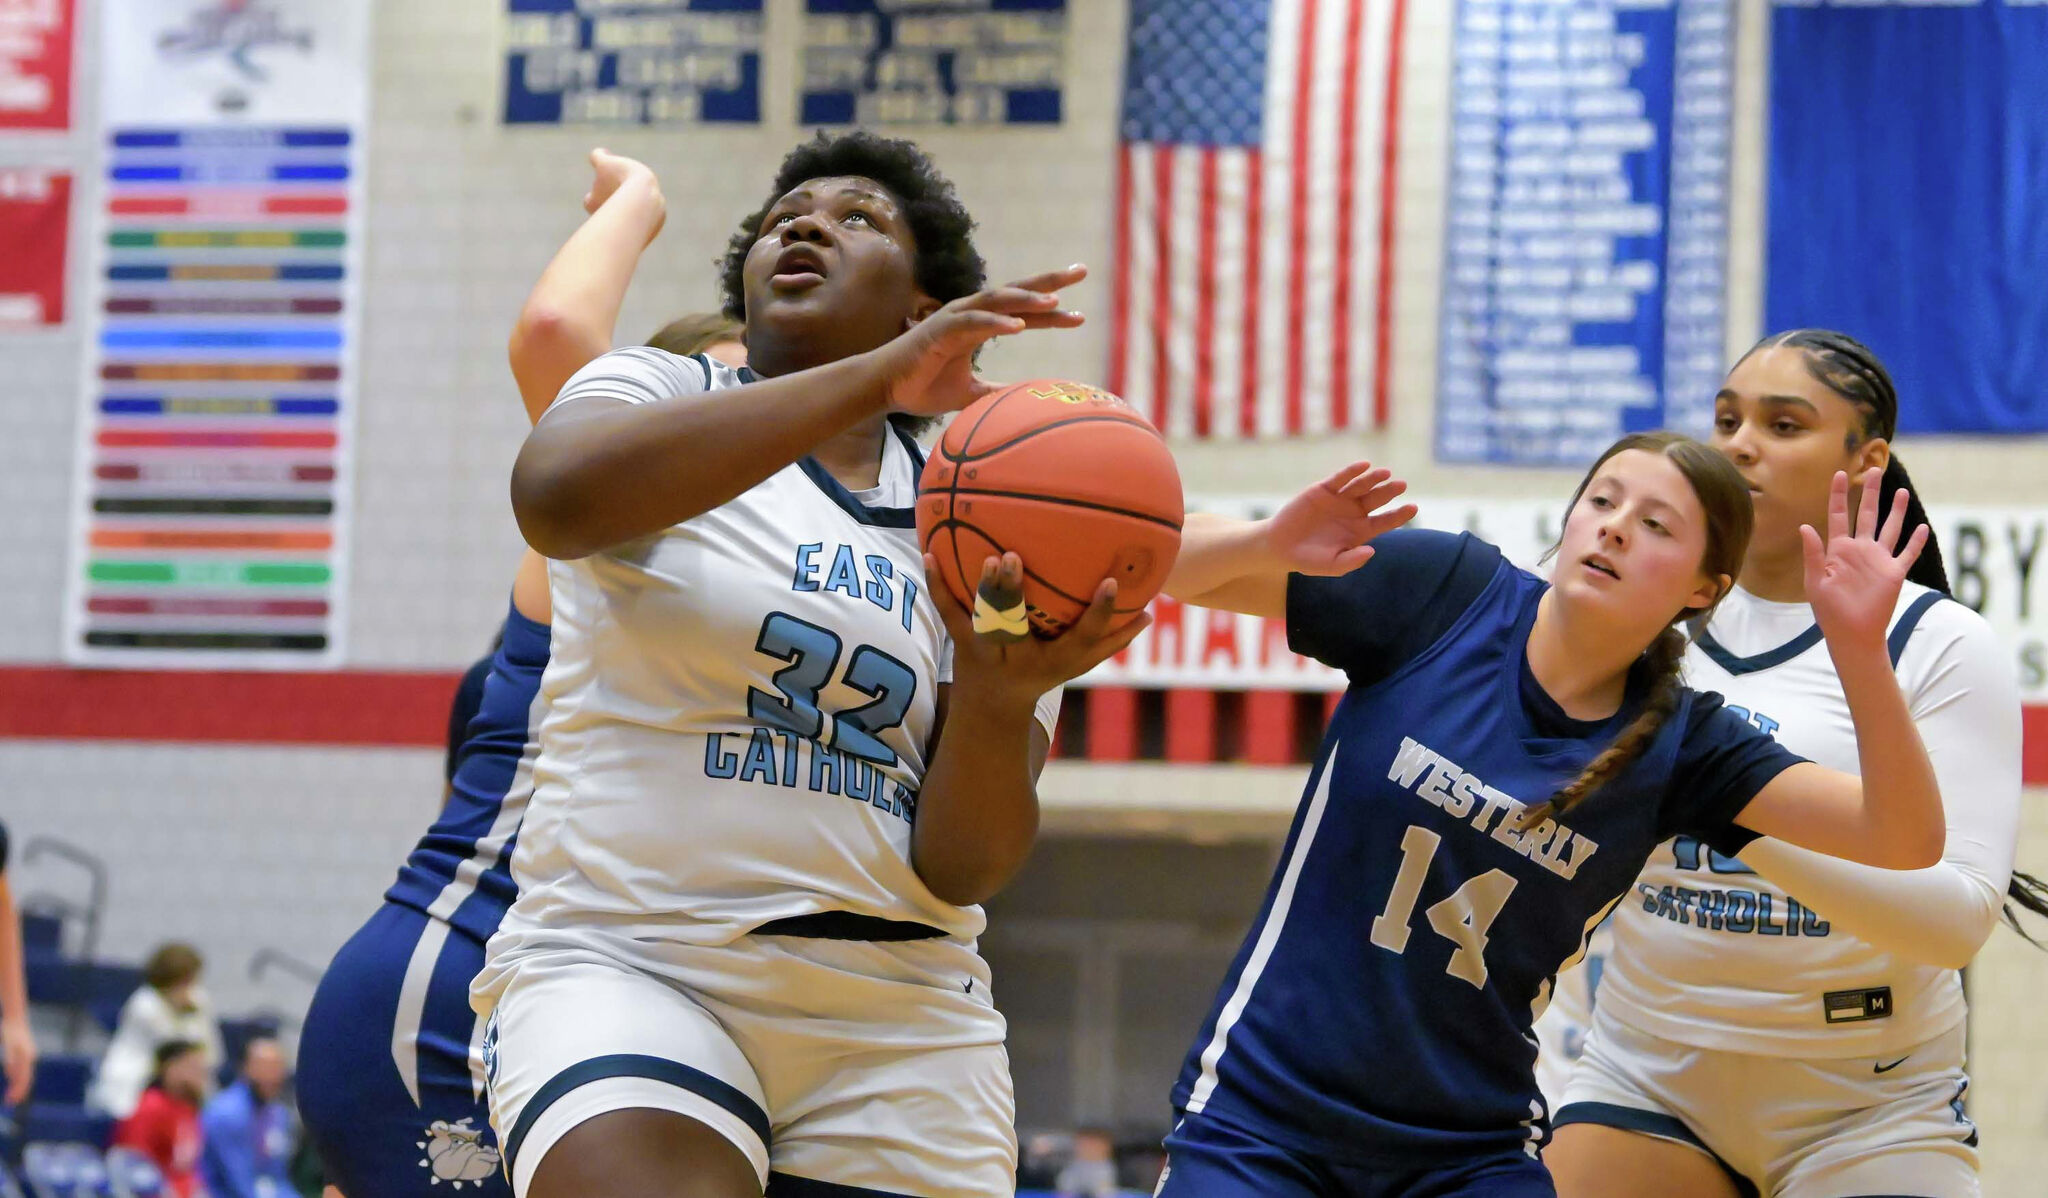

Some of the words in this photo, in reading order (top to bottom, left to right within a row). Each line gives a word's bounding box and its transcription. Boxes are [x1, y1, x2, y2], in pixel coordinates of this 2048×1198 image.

[792, 542, 917, 634] EAST
[747, 611, 916, 767] 32
[1388, 736, 1599, 880] WESTERLY
[1370, 825, 1518, 990] 14
[1872, 997, 1884, 1010] M
